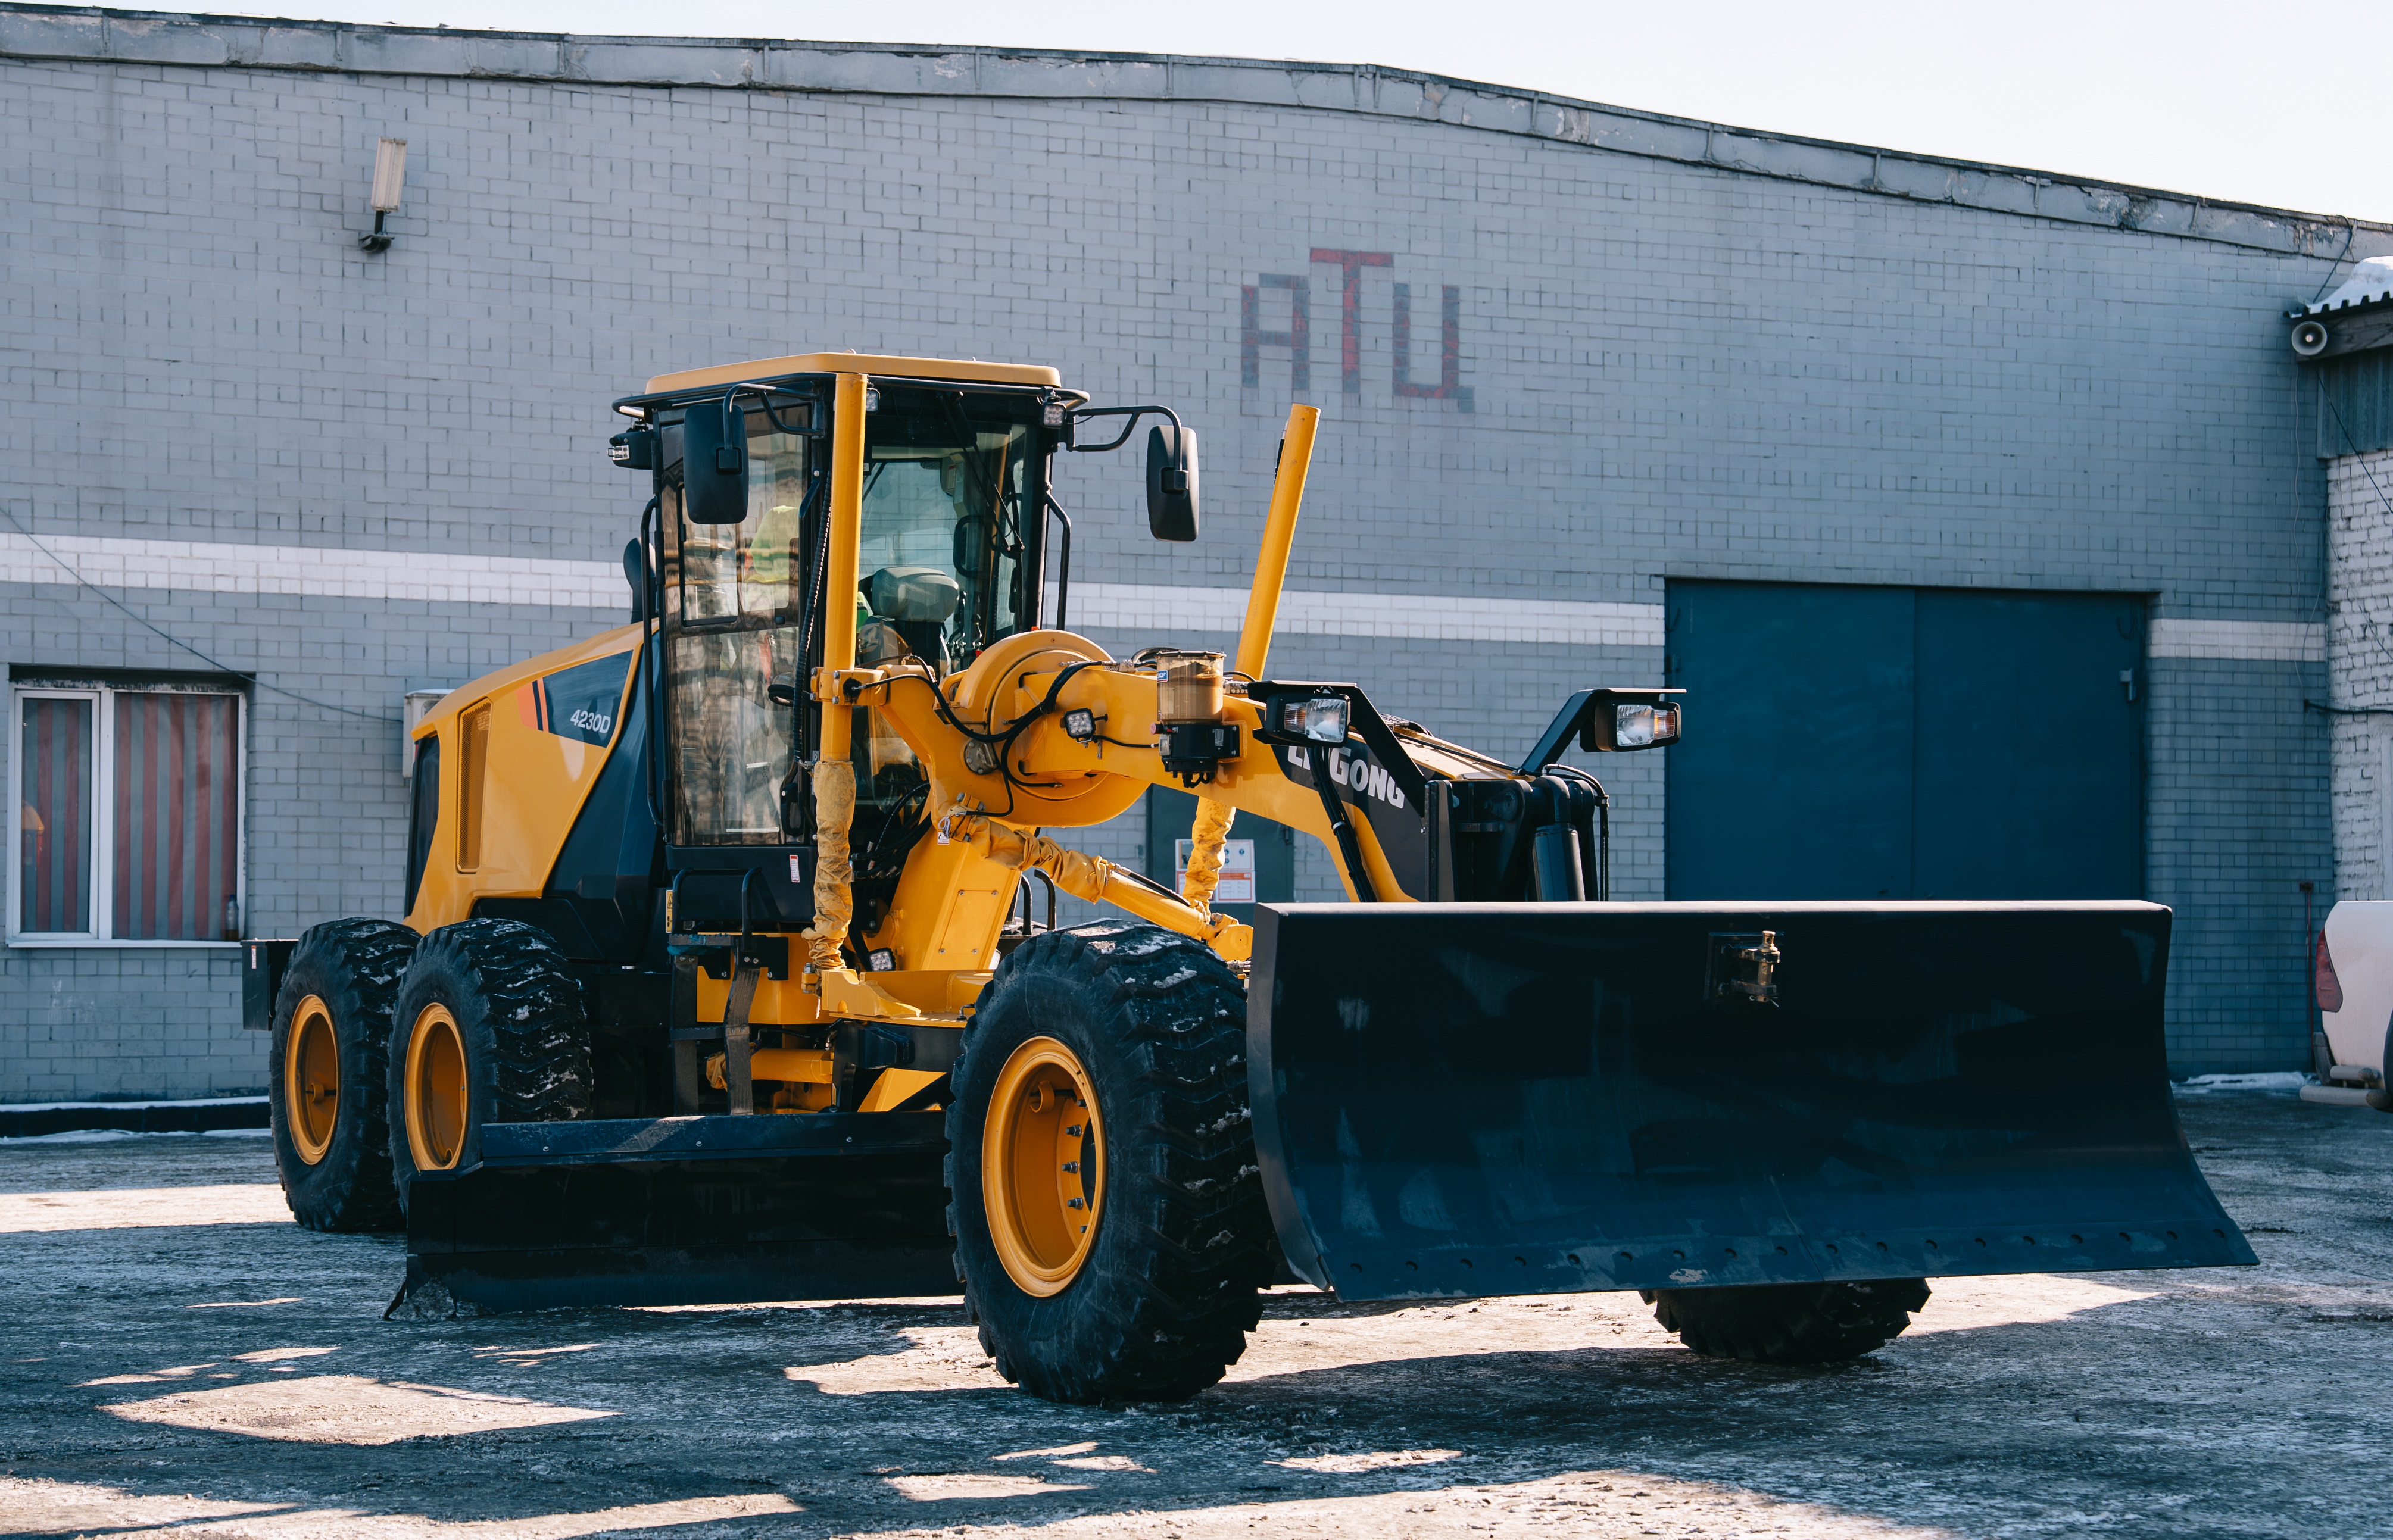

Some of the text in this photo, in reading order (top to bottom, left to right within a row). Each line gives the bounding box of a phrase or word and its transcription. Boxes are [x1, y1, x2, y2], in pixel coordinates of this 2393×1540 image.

[1241, 247, 1475, 413] АТЦ
[570, 708, 611, 734] 4230D
[1288, 745, 1405, 809] LGONG
